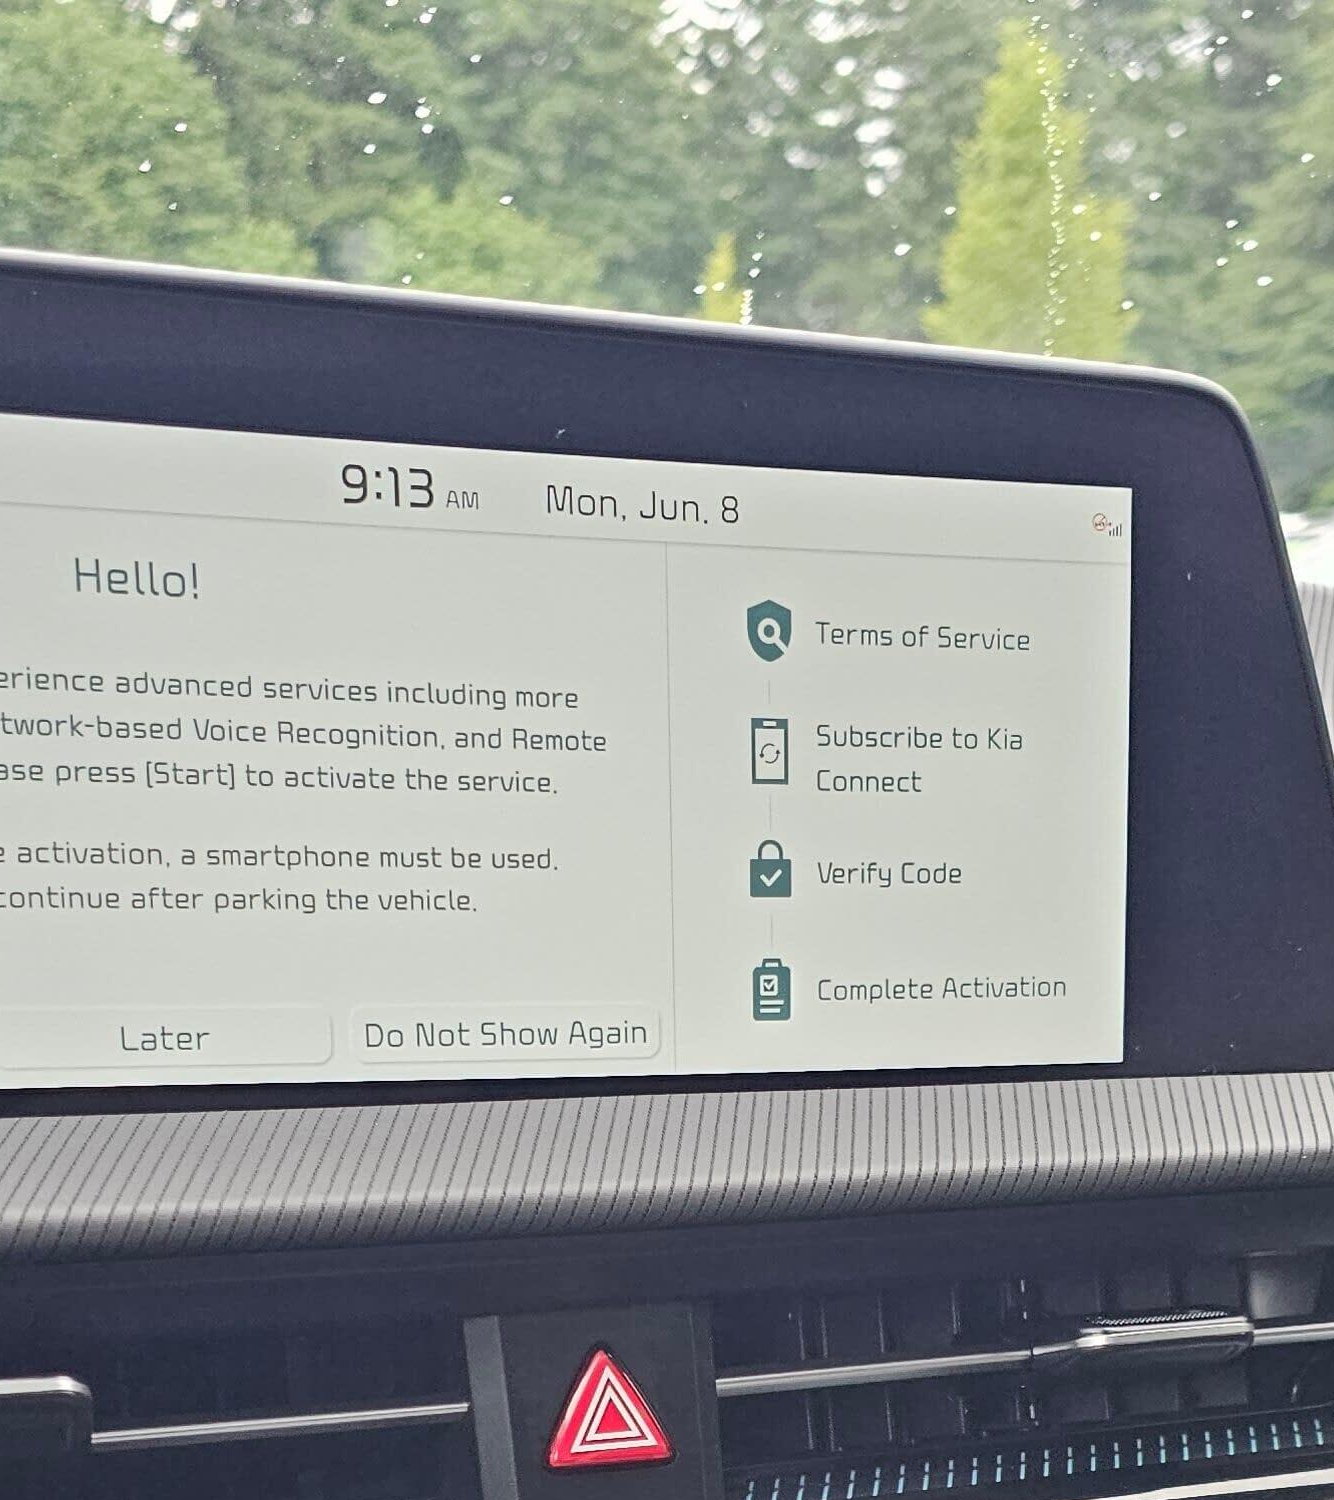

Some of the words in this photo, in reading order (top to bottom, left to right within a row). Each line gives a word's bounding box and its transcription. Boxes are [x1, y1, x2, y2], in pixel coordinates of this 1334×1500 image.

[341, 463, 434, 508] 9:13
[446, 490, 479, 510] AM
[547, 484, 626, 522] Mon,
[639, 490, 708, 525] Jun.
[721, 495, 739, 524] 8
[74, 557, 198, 600] Hello!
[815, 621, 893, 647] Terms
[902, 625, 929, 648] of
[937, 626, 1030, 651] Service
[116, 671, 252, 698] advanced
[263, 678, 377, 702] services
[387, 680, 507, 711] including
[515, 690, 578, 709] more
[192, 718, 266, 743] Voice
[277, 721, 445, 750] Recognition,
[454, 727, 502, 749] and
[512, 728, 607, 752] Remote
[816, 724, 943, 749] Subscribe
[952, 727, 978, 750] to
[988, 727, 1023, 750] Kia
[55, 765, 136, 786] press
[146, 760, 235, 791] [Start]
[245, 764, 274, 787] to
[284, 766, 395, 790] activate
[405, 768, 448, 791] the
[457, 770, 558, 794] service.
[816, 769, 922, 793] Connect
[17, 841, 170, 867] activation,
[181, 849, 196, 866] a
[206, 844, 370, 871] smartphone
[379, 846, 443, 868] must
[450, 847, 482, 869] be
[491, 847, 558, 871] used.
[817, 861, 892, 888] Verify
[901, 862, 962, 884] Code
[131, 886, 204, 909] after
[214, 887, 316, 914] parking
[325, 888, 369, 911] the
[378, 889, 477, 912] vehicle.
[818, 978, 933, 1004] Complete
[942, 976, 1066, 999] Activation
[120, 1025, 210, 1051] Later
[365, 1023, 404, 1048] Do
[416, 1022, 471, 1047] Not
[481, 1021, 558, 1046] Show
[569, 1020, 647, 1049] Again
